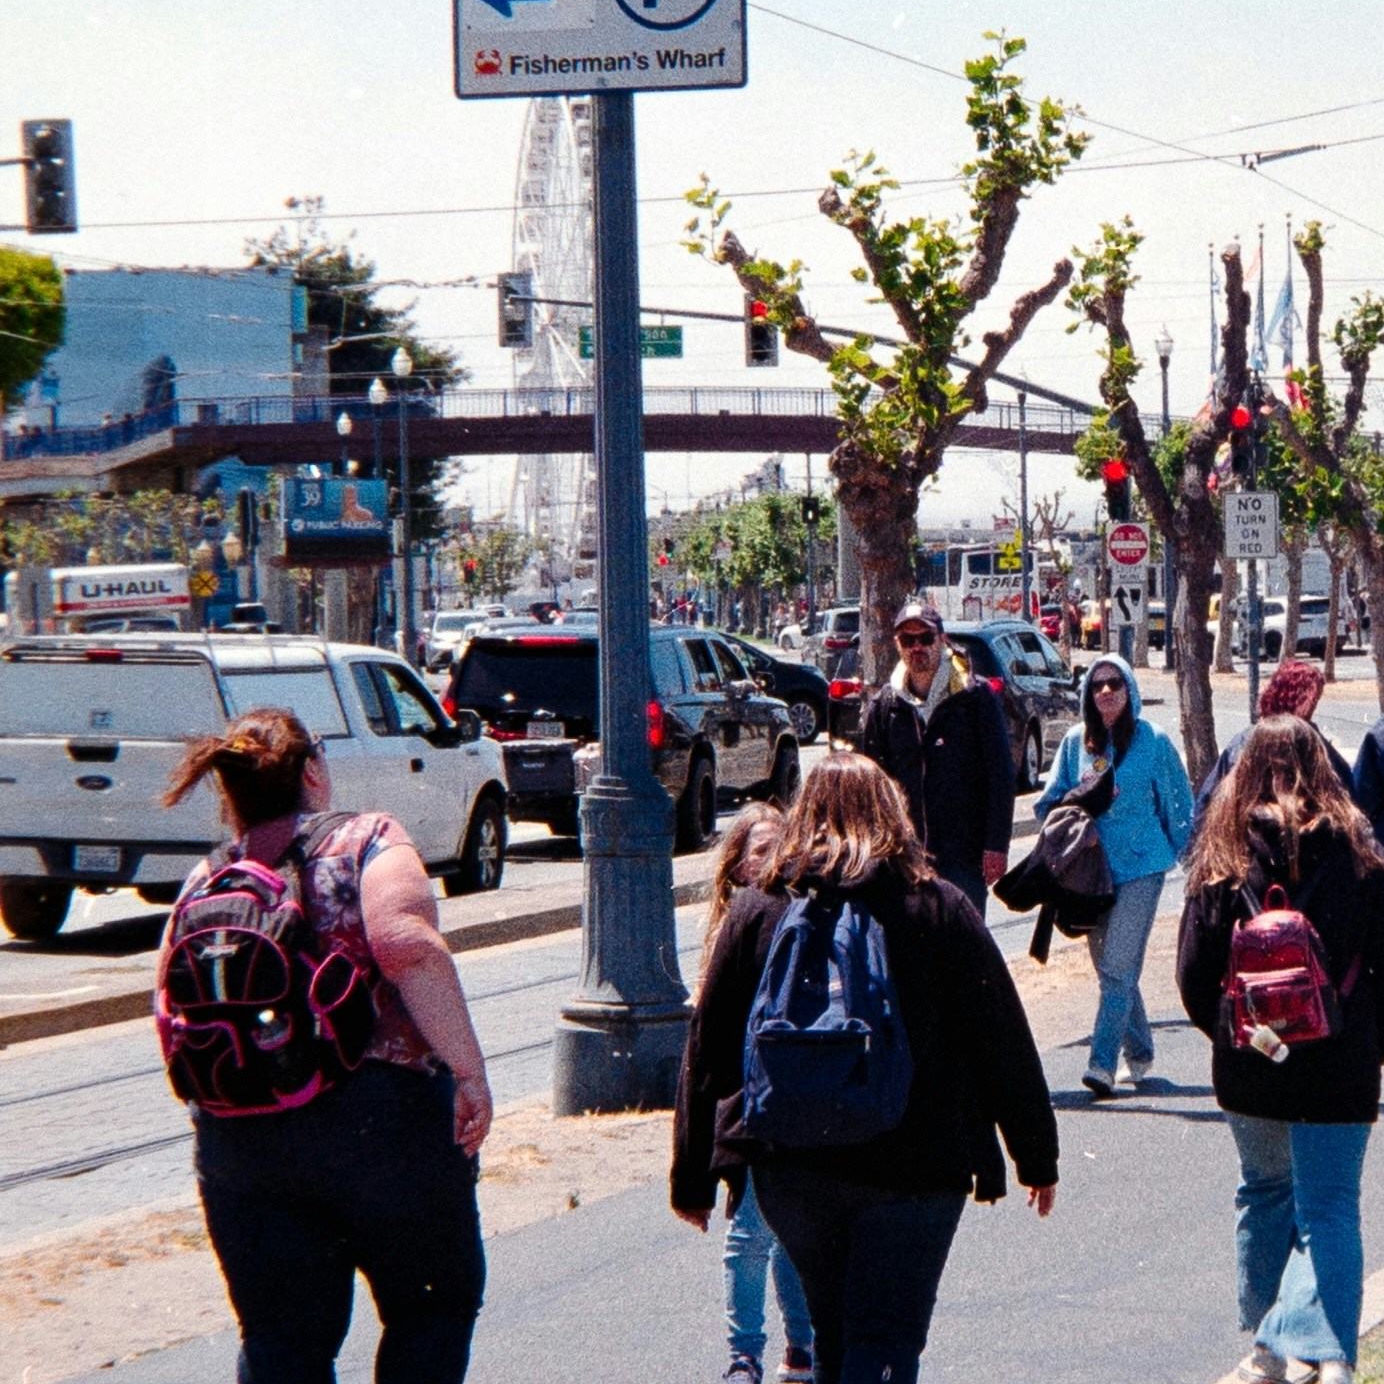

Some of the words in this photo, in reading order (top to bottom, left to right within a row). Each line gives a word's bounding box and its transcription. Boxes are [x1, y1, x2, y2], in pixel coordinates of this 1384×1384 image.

[509, 51, 650, 75] Fisherman's
[656, 47, 726, 70] Wharf
[1237, 497, 1262, 511] NO
[1235, 514, 1266, 525] TURN
[1241, 528, 1260, 539] ON
[1239, 543, 1262, 554] RED
[80, 579, 172, 598] U-HAUL
